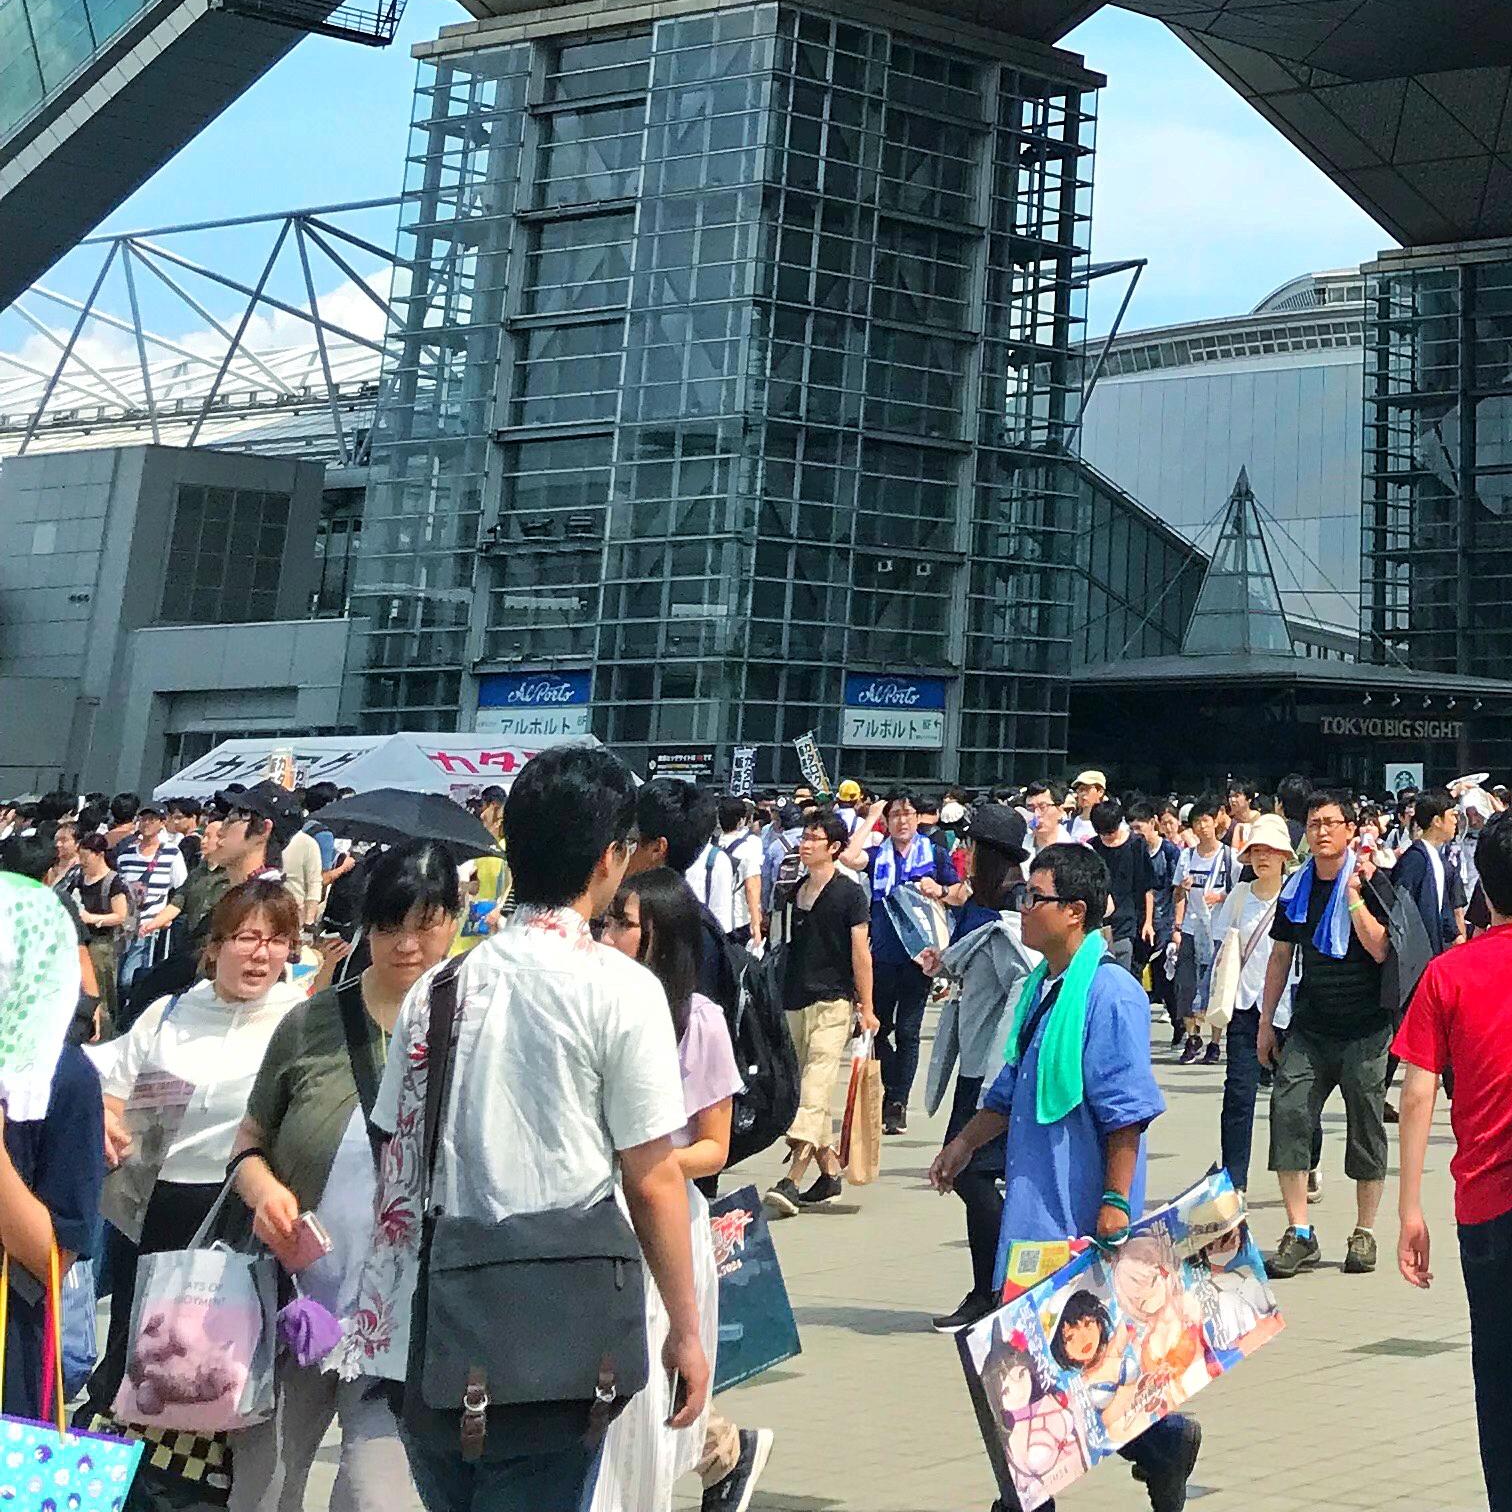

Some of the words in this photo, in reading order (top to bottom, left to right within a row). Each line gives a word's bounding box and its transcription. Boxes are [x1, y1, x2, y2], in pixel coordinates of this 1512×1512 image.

[1321, 717, 1382, 736] TOKYO
[1385, 719, 1412, 737] BIG
[1414, 720, 1463, 738] SIGHT
[427, 751, 539, 773] カタ
